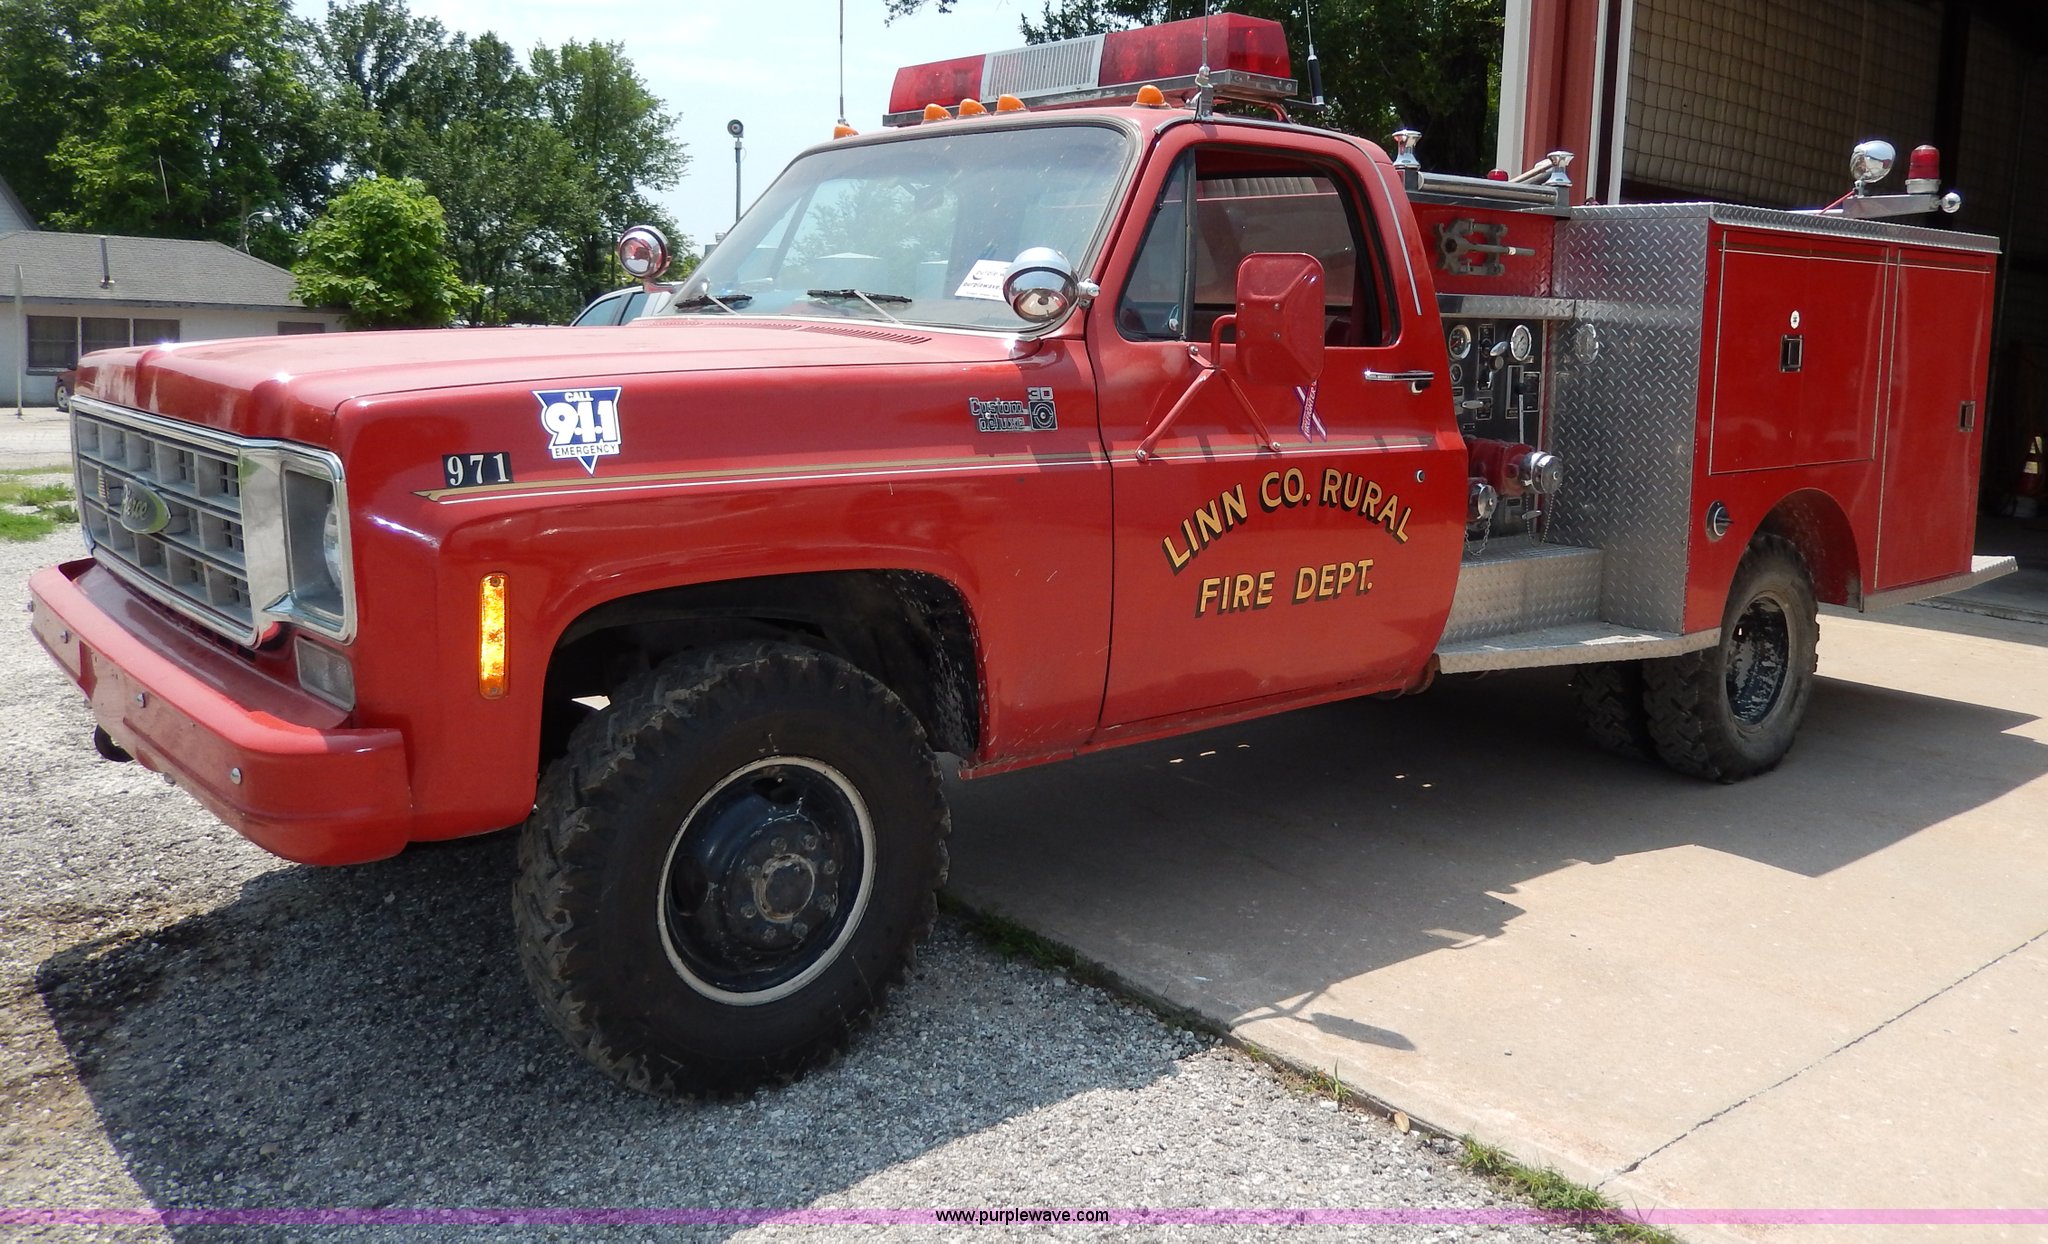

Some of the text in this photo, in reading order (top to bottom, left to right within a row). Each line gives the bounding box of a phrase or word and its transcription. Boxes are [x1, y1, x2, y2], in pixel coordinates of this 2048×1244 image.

[564, 390, 594, 402] CALL
[969, 397, 1024, 416] Custom
[979, 412, 1026, 432] deluxe
[554, 443, 617, 458] EMERGENCY
[446, 452, 510, 487] 971
[1162, 467, 1412, 575] LINN CO. RURAL
[1196, 558, 1375, 617] FIRE DEPT.
